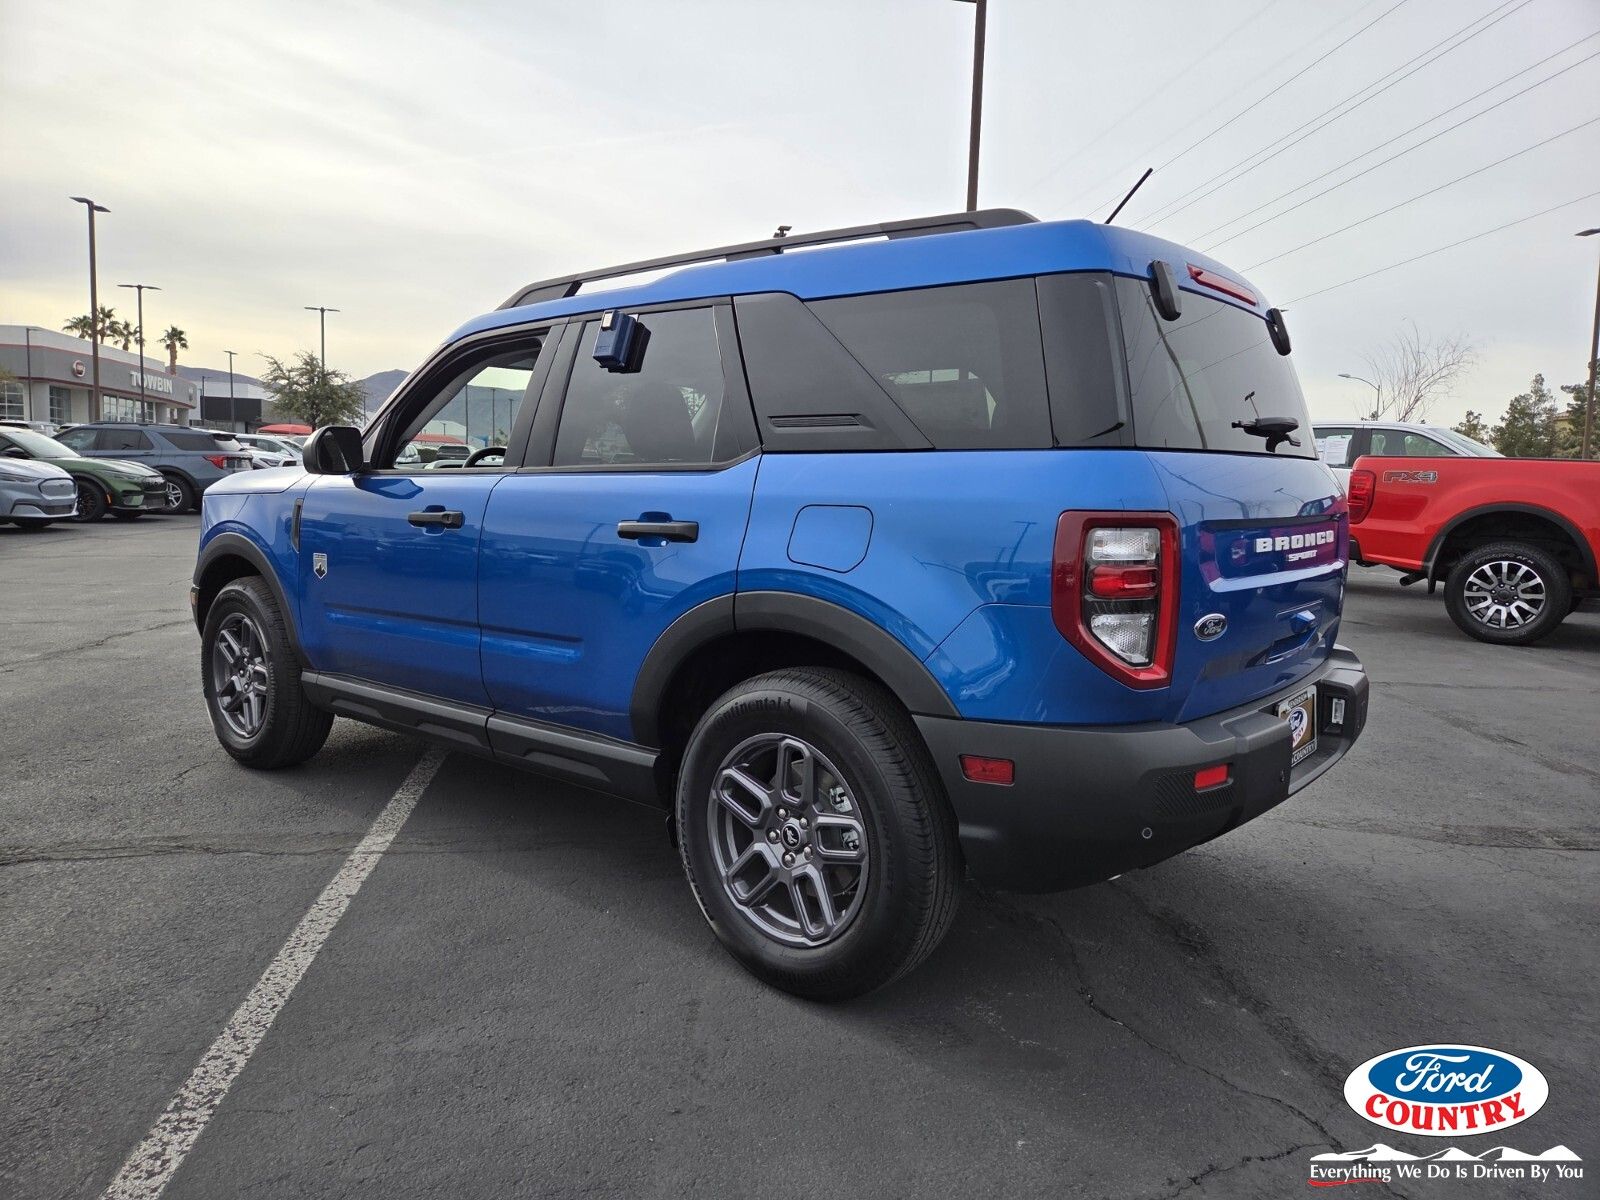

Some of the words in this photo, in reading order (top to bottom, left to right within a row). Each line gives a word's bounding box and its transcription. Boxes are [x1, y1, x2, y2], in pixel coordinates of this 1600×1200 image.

[1383, 470, 1438, 483] FX4
[1254, 530, 1335, 553] BRONCO
[1287, 549, 1318, 562] SPORT
